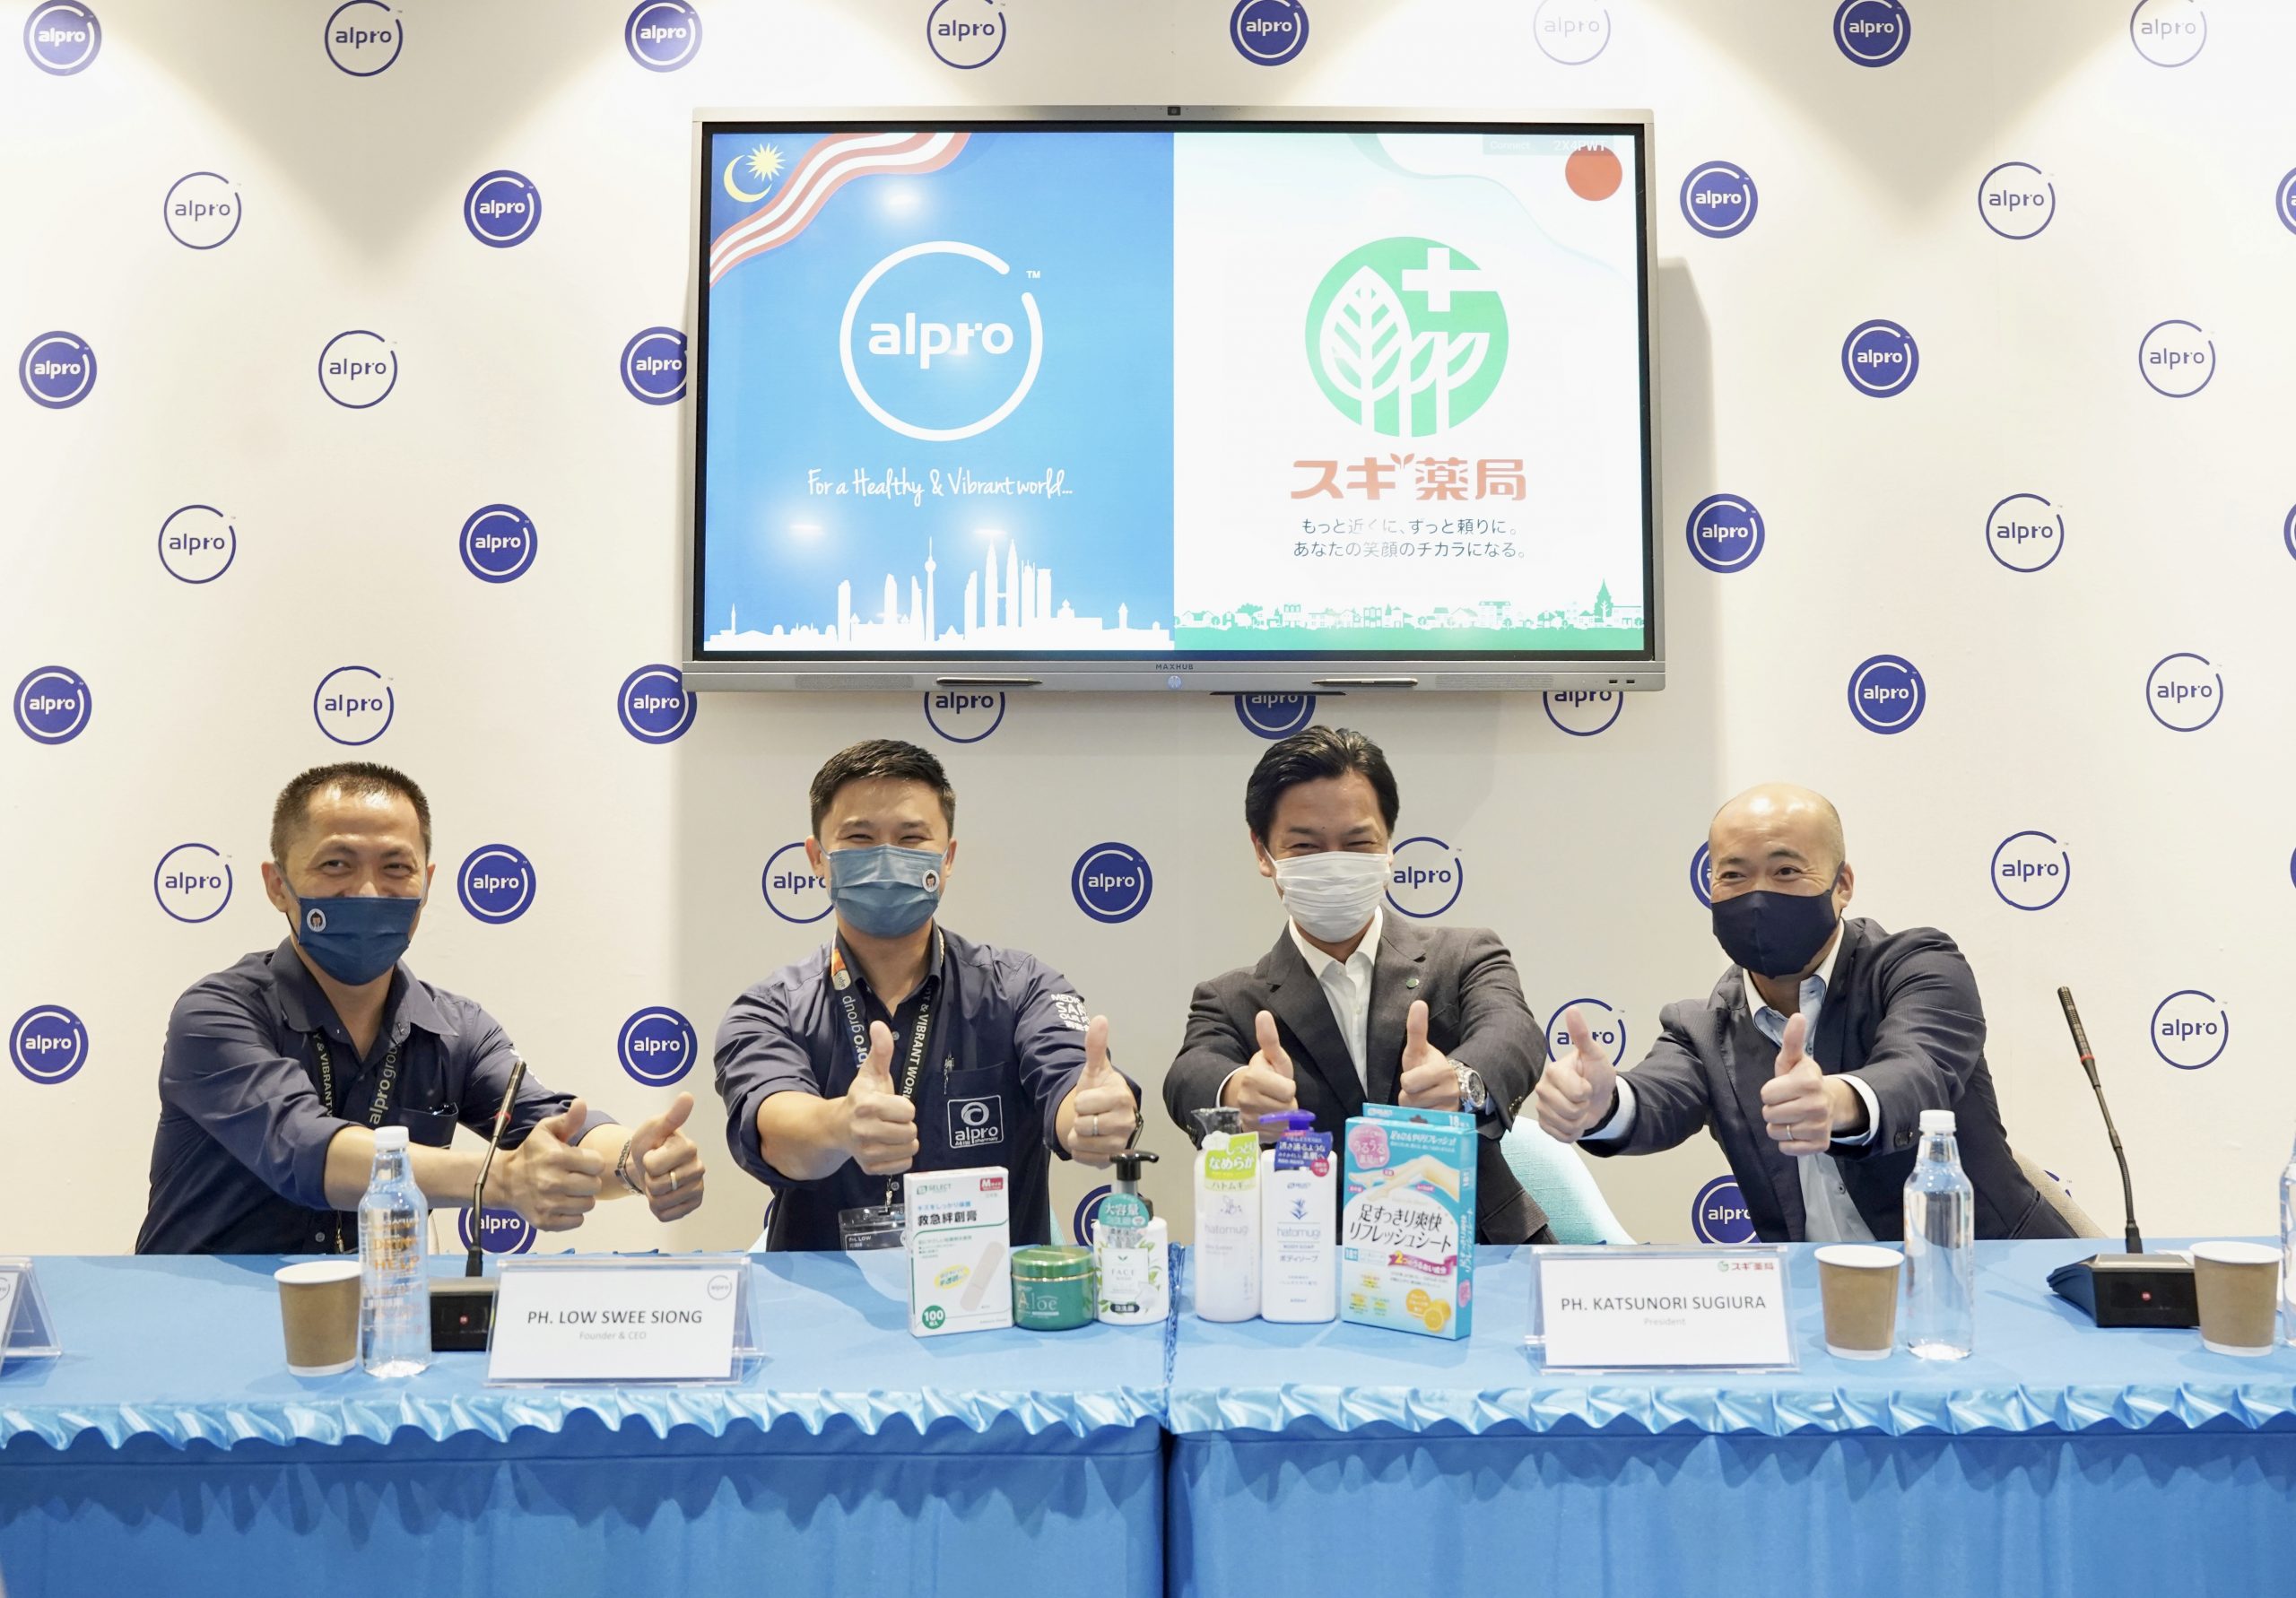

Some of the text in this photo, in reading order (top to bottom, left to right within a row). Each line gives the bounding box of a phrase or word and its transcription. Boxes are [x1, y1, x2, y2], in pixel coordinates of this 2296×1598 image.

[38, 27, 86, 48] alpro
[335, 26, 392, 49] alpro
[639, 24, 687, 44] alpro
[937, 19, 996, 42] alpro
[1246, 18, 1292, 37] alpro
[1544, 16, 1600, 39] alpro
[1848, 19, 1895, 38] alpro
[2141, 18, 2196, 40] alpro
[479, 199, 526, 219] alpro
[1695, 189, 1742, 209] alpro
[1988, 189, 2045, 213] alpro
[174, 200, 230, 222] alpro
[868, 312, 1014, 369] alpro
[635, 356, 683, 376] alpro
[1857, 349, 1903, 368] alpro
[2149, 347, 2205, 370] alpro
[34, 360, 82, 379] alpro
[329, 358, 387, 381] alpro
[807, 468, 834, 496] For
[836, 481, 849, 496] a
[851, 467, 926, 508] Healthy
[931, 469, 944, 497] &
[947, 466, 1014, 497] Vibrant
[1290, 452, 1527, 502] スギ薬局
[1702, 524, 1749, 543] alpro
[1996, 521, 2054, 544] alpro
[169, 533, 225, 556] alpro
[474, 534, 521, 553] alpro
[1292, 540, 1526, 559] あなたの笑顔のチカラになる。
[1155, 663, 1194, 671] MAXHUB
[935, 691, 995, 715] alpro
[1863, 684, 1909, 704] alpro
[2157, 681, 2213, 704] alpro
[29, 695, 76, 715] alpro
[324, 694, 383, 717] alpro
[633, 694, 680, 714] alpro
[1393, 865, 1452, 890] alpro
[2002, 859, 2059, 882] alpro
[165, 872, 222, 895] alpro
[473, 873, 519, 894] alpro
[1088, 873, 1135, 892] alpro
[842, 995, 865, 1034] group
[911, 1014, 929, 1065] VIBRANT
[2161, 1018, 2218, 1042] alpro
[25, 1034, 72, 1055] alpro
[633, 1037, 681, 1056] alpro
[319, 1052, 333, 1107] VIBRANT
[370, 1079, 390, 1125] alpro
[954, 1126, 999, 1144] alpro
[1208, 1156, 1255, 1170] なめらか
[1105, 1203, 1139, 1216] 大容量
[1358, 1203, 1443, 1232] 足すっきり爽快
[1350, 1221, 1451, 1253] リフレッシュシート
[1111, 1268, 1135, 1276] FACE
[1018, 1290, 1058, 1311] Aloe
[1561, 1296, 1766, 1311] PH. KATSUNORI SUGIURA
[527, 1310, 702, 1324] PH. LOW SWEE SIONG
[924, 1309, 944, 1322] 100
[1644, 1317, 1686, 1326] President
[579, 1330, 647, 1340] Founder & CEO
